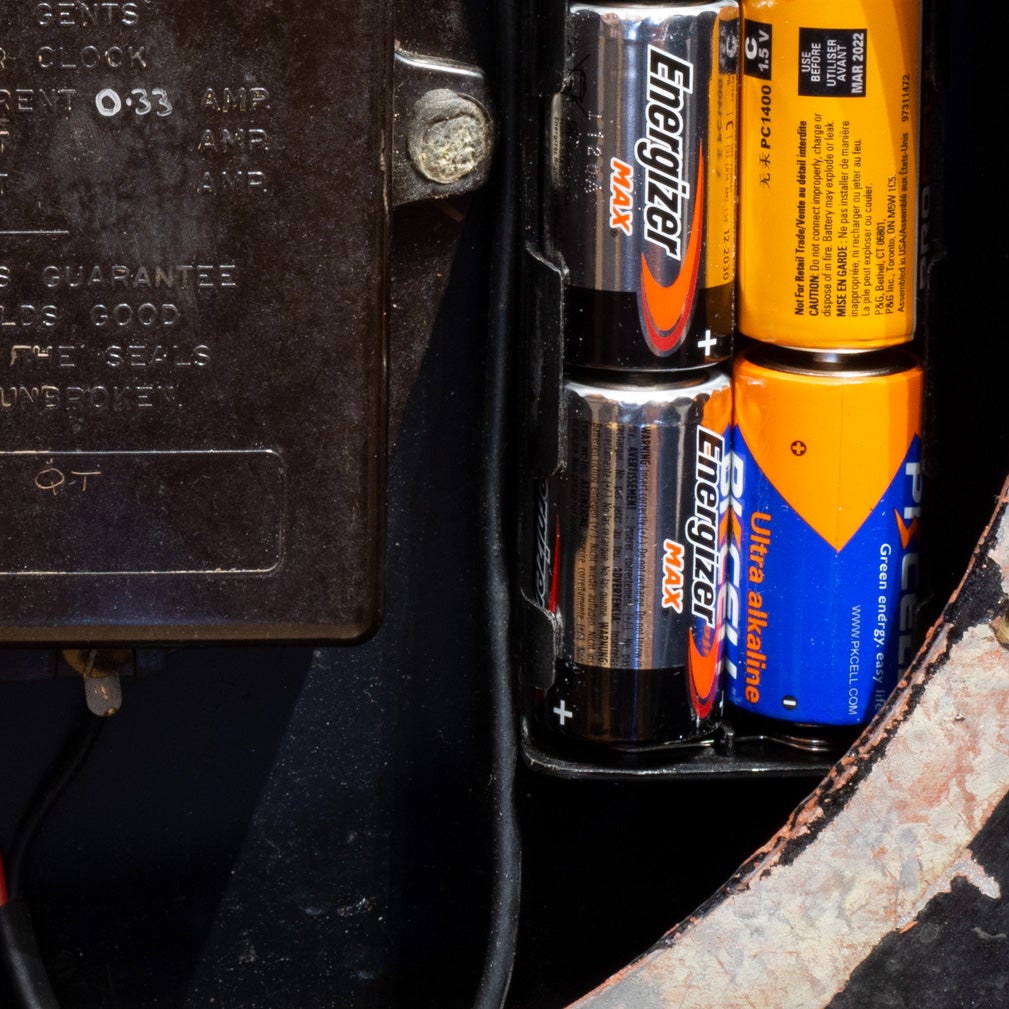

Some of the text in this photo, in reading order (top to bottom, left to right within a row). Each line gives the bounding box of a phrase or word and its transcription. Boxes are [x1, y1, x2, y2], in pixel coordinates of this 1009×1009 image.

[37, 45, 149, 70] CLOCK
[744, 36, 758, 60] C
[758, 29, 770, 72] 1.5 V
[801, 51, 811, 73] USE
[811, 42, 821, 82] BEFORE
[826, 39, 837, 87] UTILISER
[837, 44, 847, 82] AVANT
[851, 32, 864, 93] MAR 2022
[760, 84, 772, 150] PC1400
[900, 73, 911, 122] 97311472
[634, 44, 694, 262] Energizer
[853, 138, 862, 155] feu.
[854, 156, 862, 168] au
[609, 157, 634, 236] MAX
[852, 170, 863, 190] jeter
[854, 192, 861, 203] ou
[795, 121, 807, 315] Not For Retail Trade/Vente au détail interdite
[809, 112, 824, 317] CAUTION: Do not connect improperly, charge or
[822, 120, 836, 317] dispose of in fire. Battery may explode or leak.
[837, 121, 850, 317] MISE EN GARDE Ne pas installer de manière
[851, 205, 862, 248] recharger
[887, 220, 896, 234] ON
[722, 228, 731, 281] 12-2030
[851, 250, 860, 258] ni
[862, 183, 875, 317] La pile peut exploser ou couler.
[876, 248, 885, 259] CT
[898, 257, 907, 265] in
[41, 264, 238, 289] GUARANTEE
[897, 267, 907, 313] Assembled
[91, 302, 181, 328] GOOD
[875, 292, 886, 316] P&G,
[886, 294, 895, 315] P&G
[9, 344, 77, 368] THE
[105, 344, 211, 368] SEALS
[684, 423, 726, 629] Energizer
[662, 539, 685, 613] MAX
[878, 542, 892, 590] Green
[744, 511, 772, 704] Ultra alkaline
[848, 604, 861, 716] WWW.PKCELL.COM
[872, 652, 885, 684] easy
